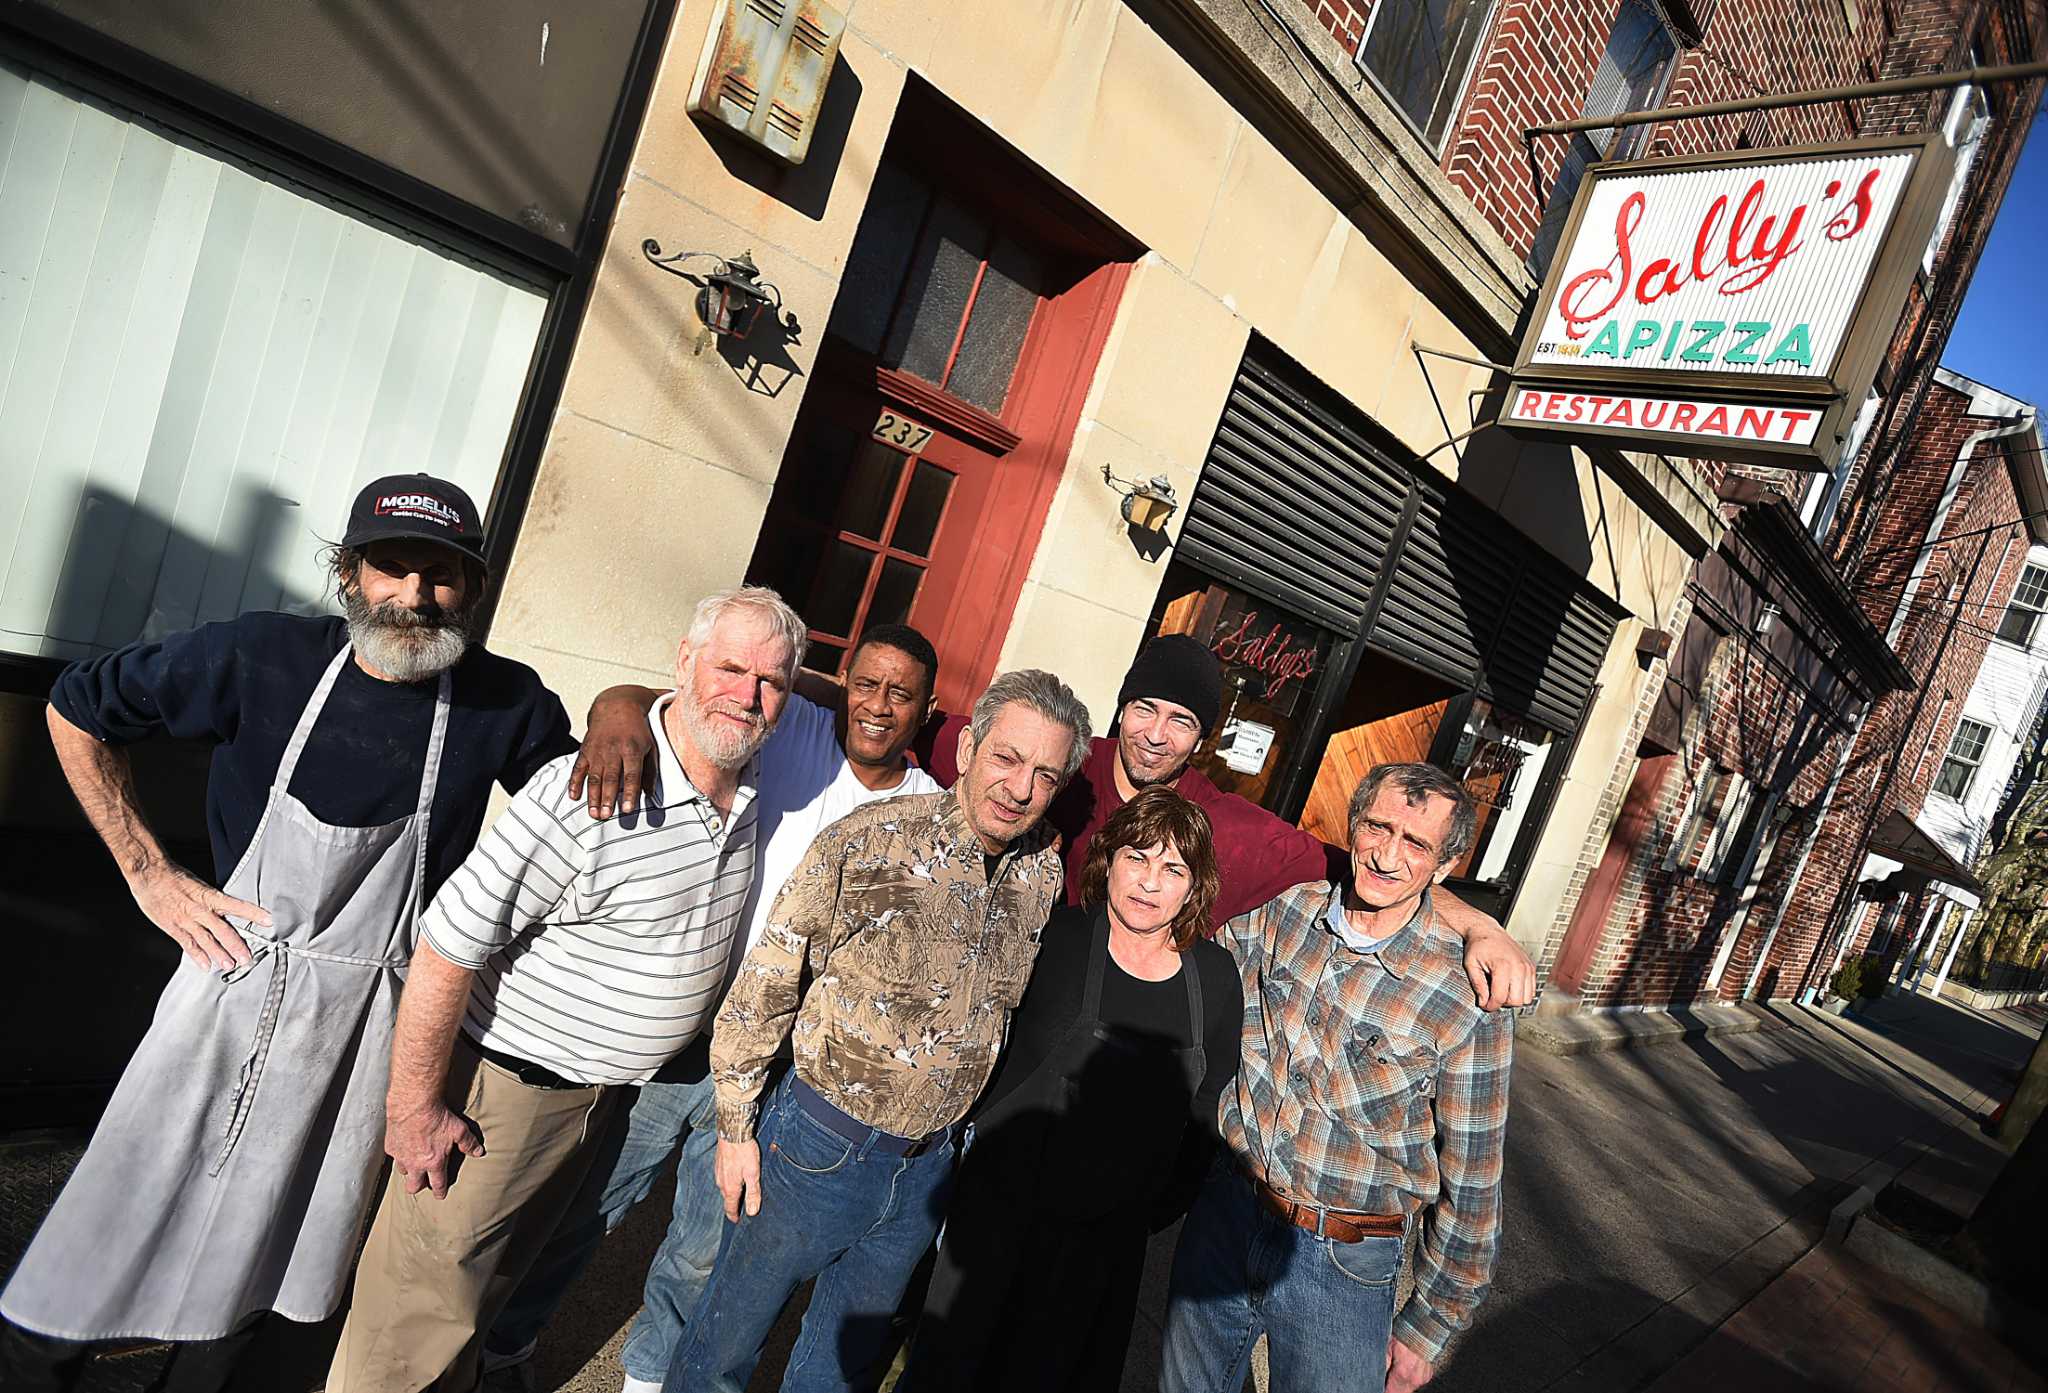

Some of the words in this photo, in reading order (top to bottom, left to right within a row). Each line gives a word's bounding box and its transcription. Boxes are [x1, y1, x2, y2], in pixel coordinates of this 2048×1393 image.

[1559, 168, 1880, 340] Sally's
[1537, 342, 1557, 353] EST
[1581, 320, 1813, 368] APIZZA
[874, 415, 931, 448] 237
[1518, 391, 1811, 442] RESTAURANT
[381, 495, 461, 523] MODELL'S
